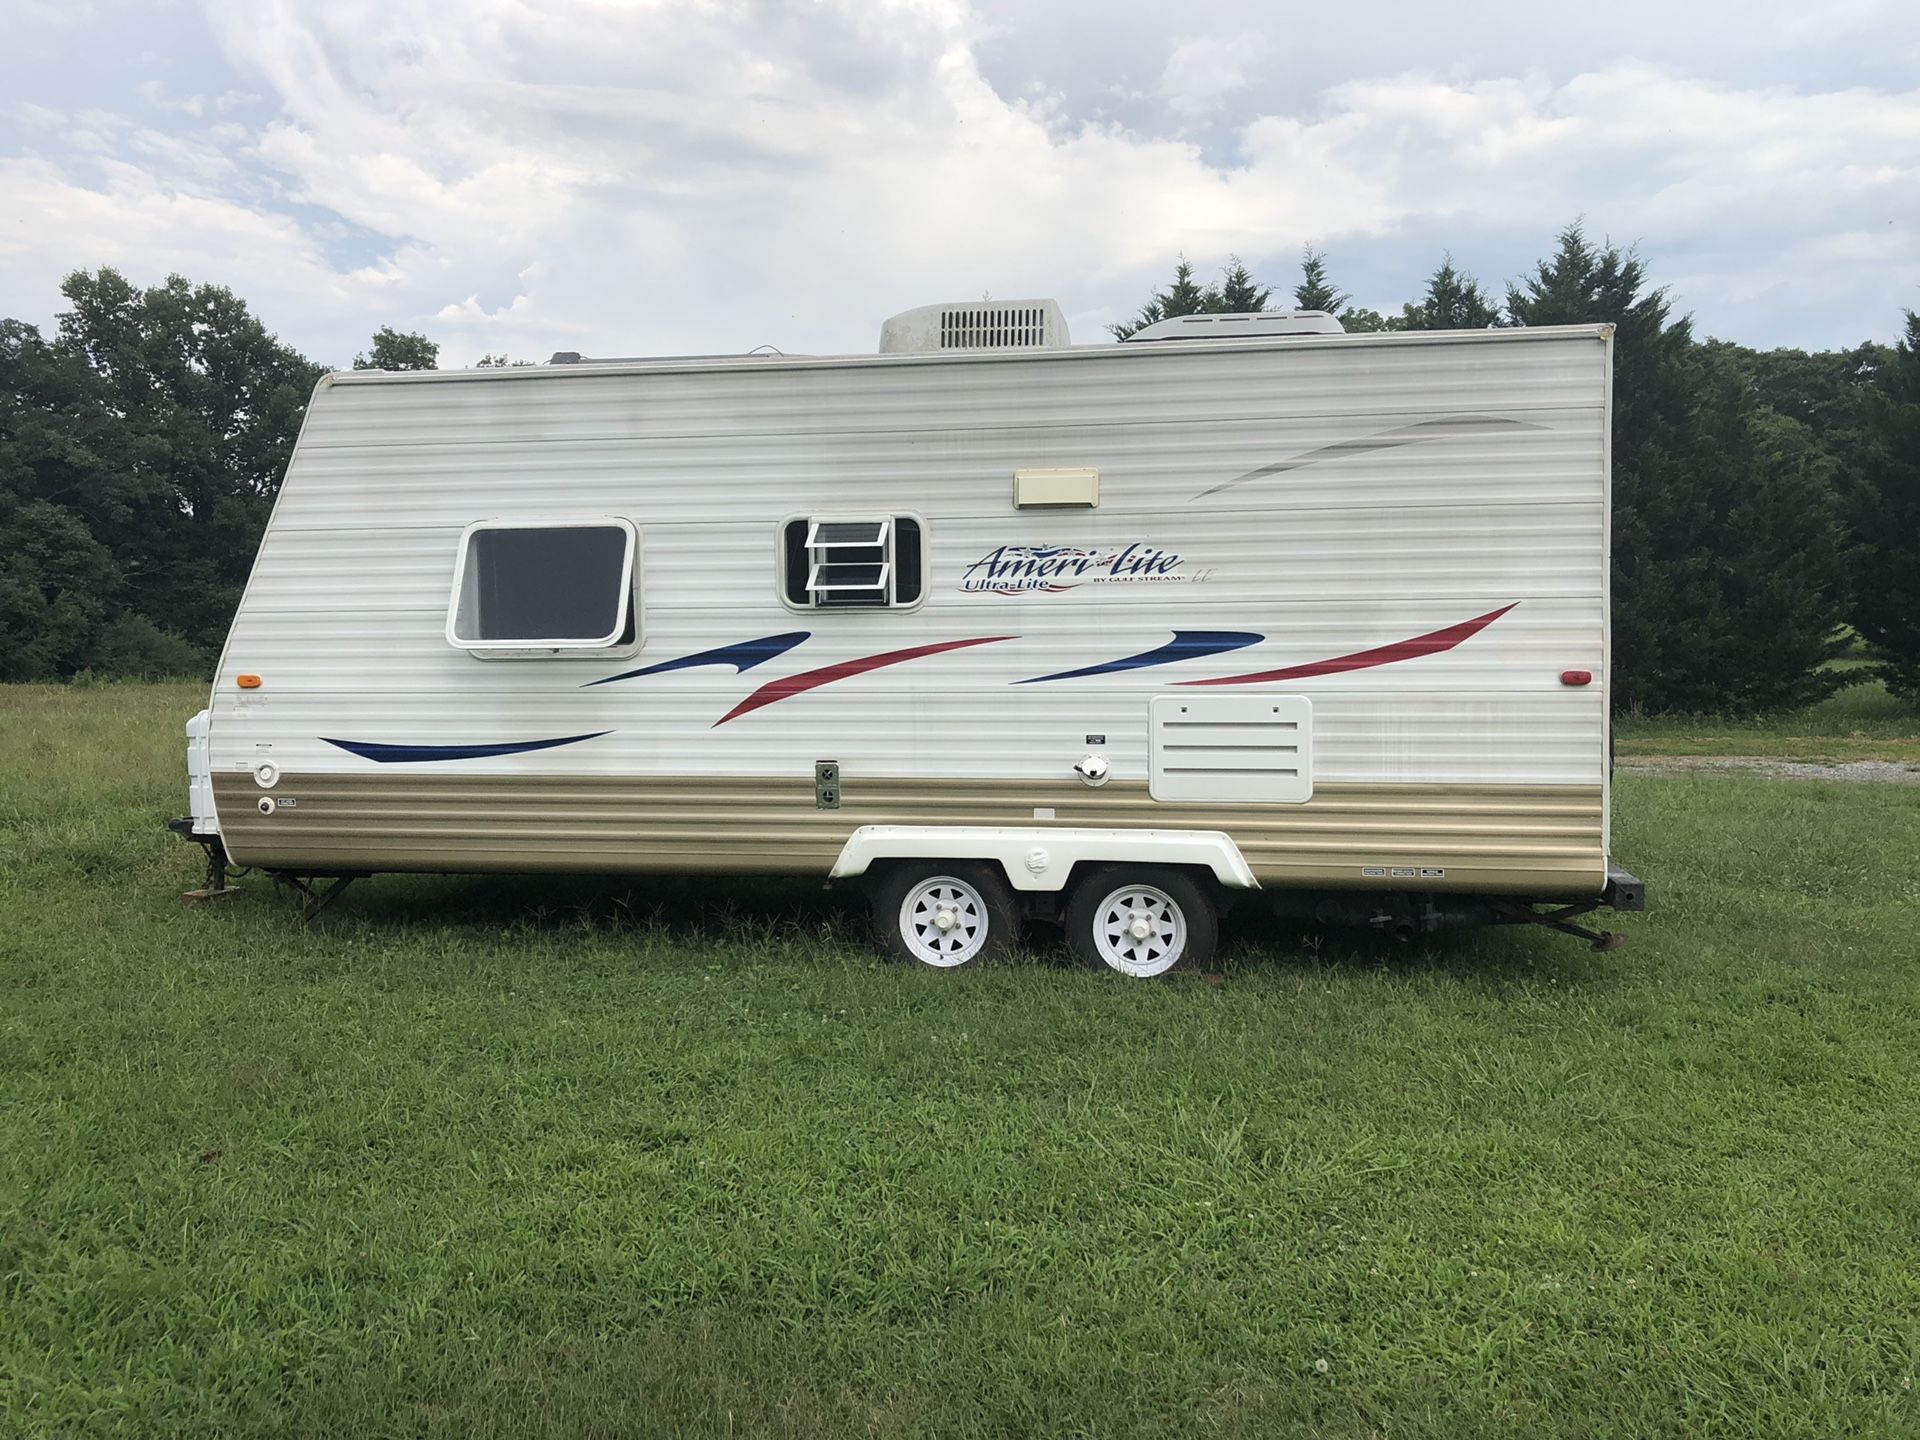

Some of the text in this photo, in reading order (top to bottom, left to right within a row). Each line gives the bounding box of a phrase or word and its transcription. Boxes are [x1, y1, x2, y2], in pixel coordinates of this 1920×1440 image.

[962, 542, 1185, 580] Ameri Lite
[965, 578, 1049, 591] Ultra-Lite
